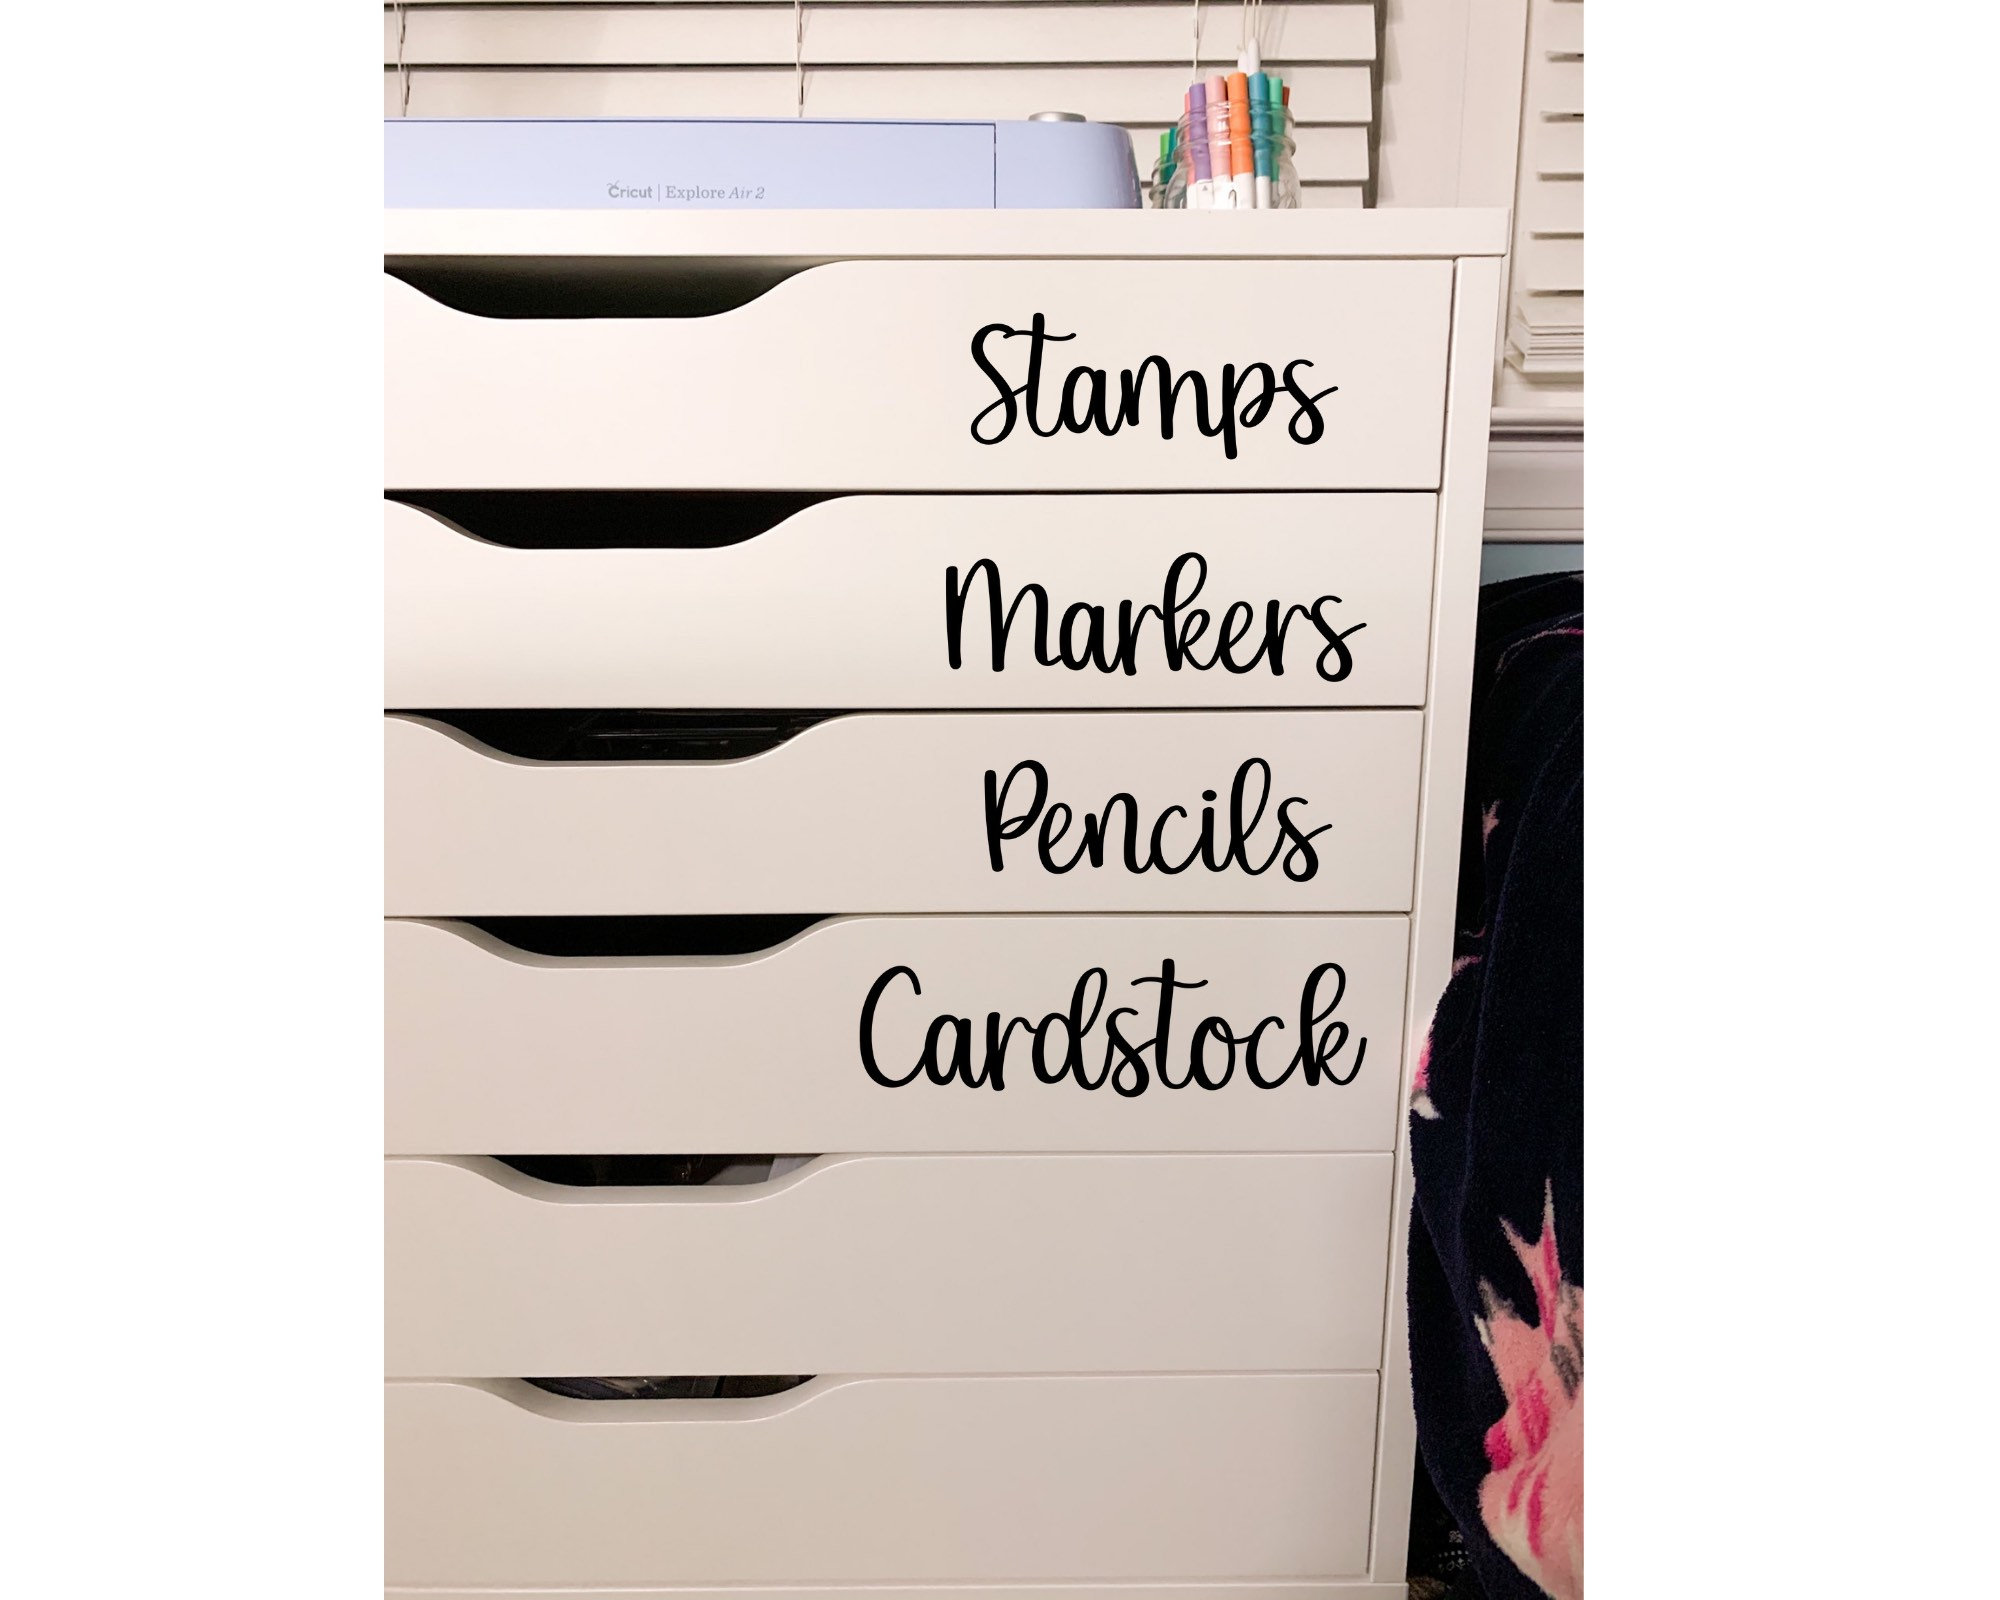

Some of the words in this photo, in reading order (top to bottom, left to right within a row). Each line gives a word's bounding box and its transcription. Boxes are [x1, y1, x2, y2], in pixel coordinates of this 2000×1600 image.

[607, 180, 653, 199] Cricut
[665, 185, 726, 202] Explore
[728, 186, 753, 199] Air
[755, 186, 765, 199] 2
[970, 312, 1339, 460] Stamps
[945, 551, 1368, 683] Markers
[984, 757, 1333, 883] Pencils
[859, 958, 1368, 1098] Cardstock
